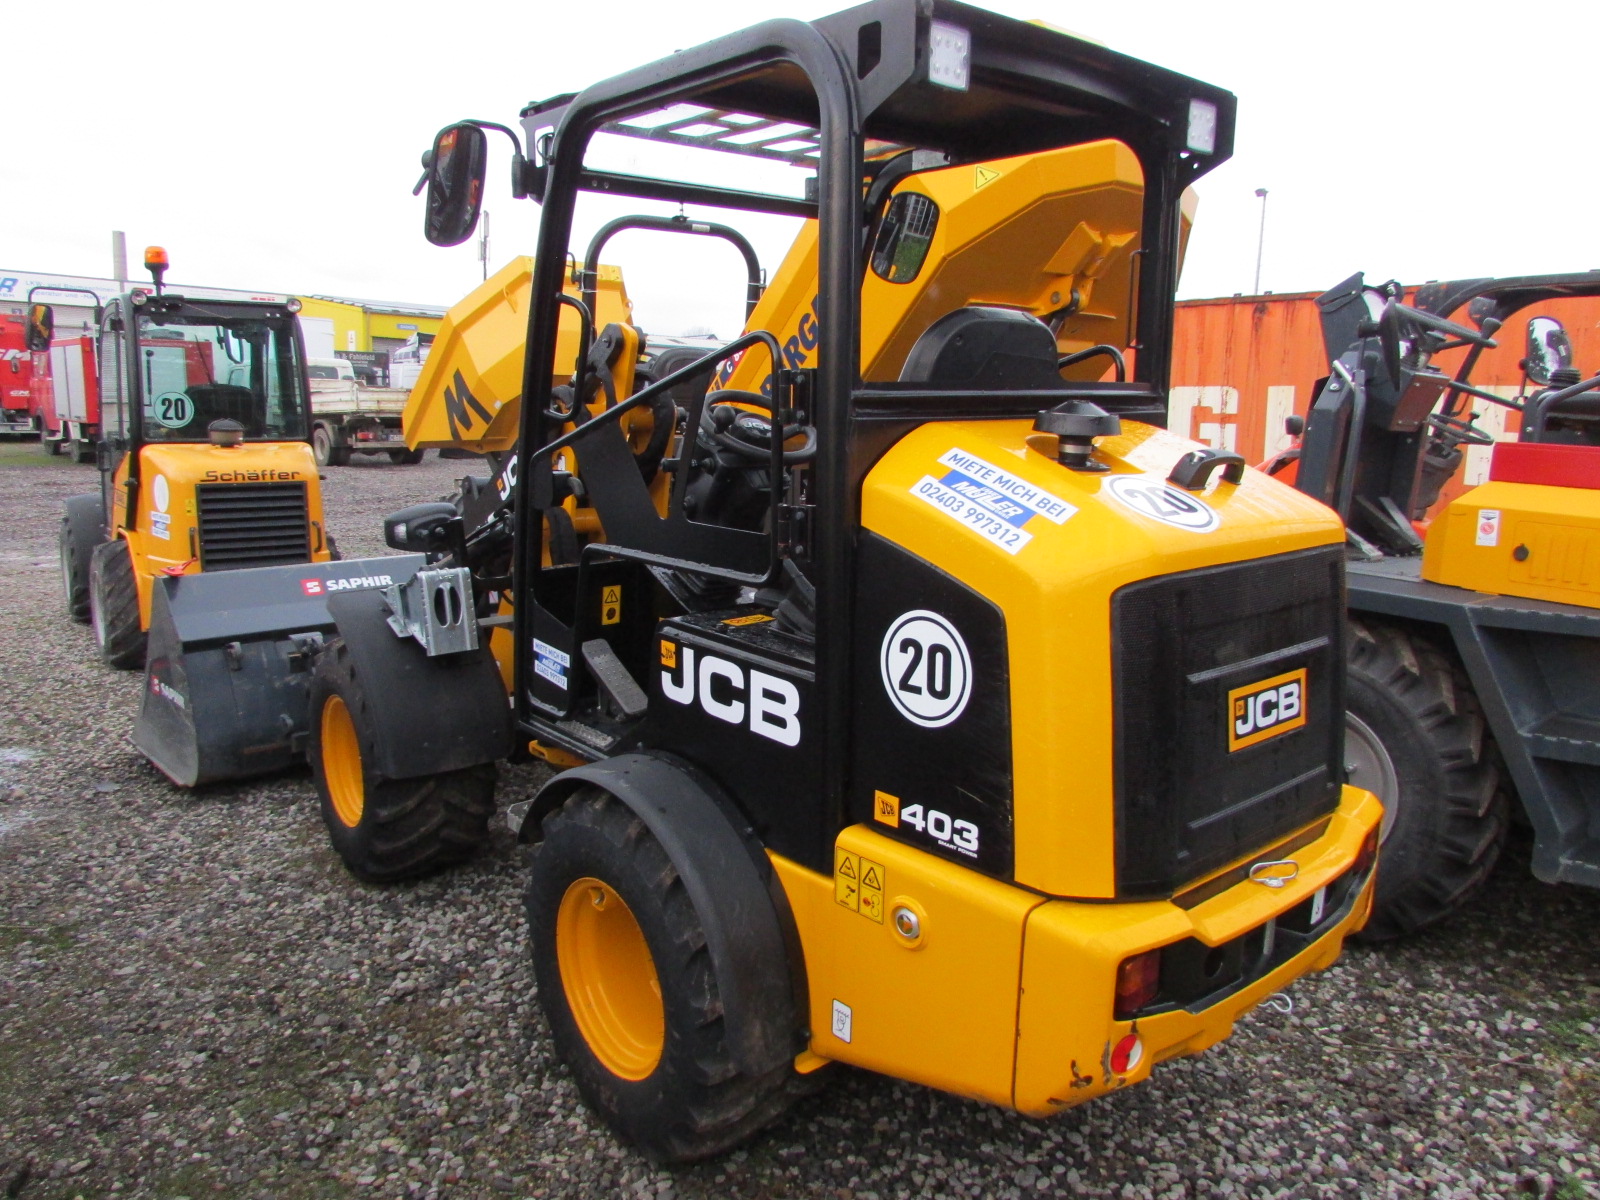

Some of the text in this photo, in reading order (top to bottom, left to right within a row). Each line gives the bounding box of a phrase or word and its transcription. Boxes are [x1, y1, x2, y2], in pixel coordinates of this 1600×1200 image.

[161, 397, 186, 421] 20
[200, 469, 300, 482] Schäffer
[500, 455, 518, 501] JC
[948, 453, 996, 481] MIETE
[993, 475, 1037, 502] MICH
[1035, 497, 1068, 518] BEI
[919, 482, 1020, 547] 02403 997312
[1123, 486, 1199, 518] 20
[326, 575, 393, 591] SAPHIR
[898, 637, 952, 700] 20
[661, 646, 801, 747] JCB
[1235, 682, 1300, 735] JCB
[901, 803, 979, 852] 403
[937, 839, 978, 858] SMART POWER
